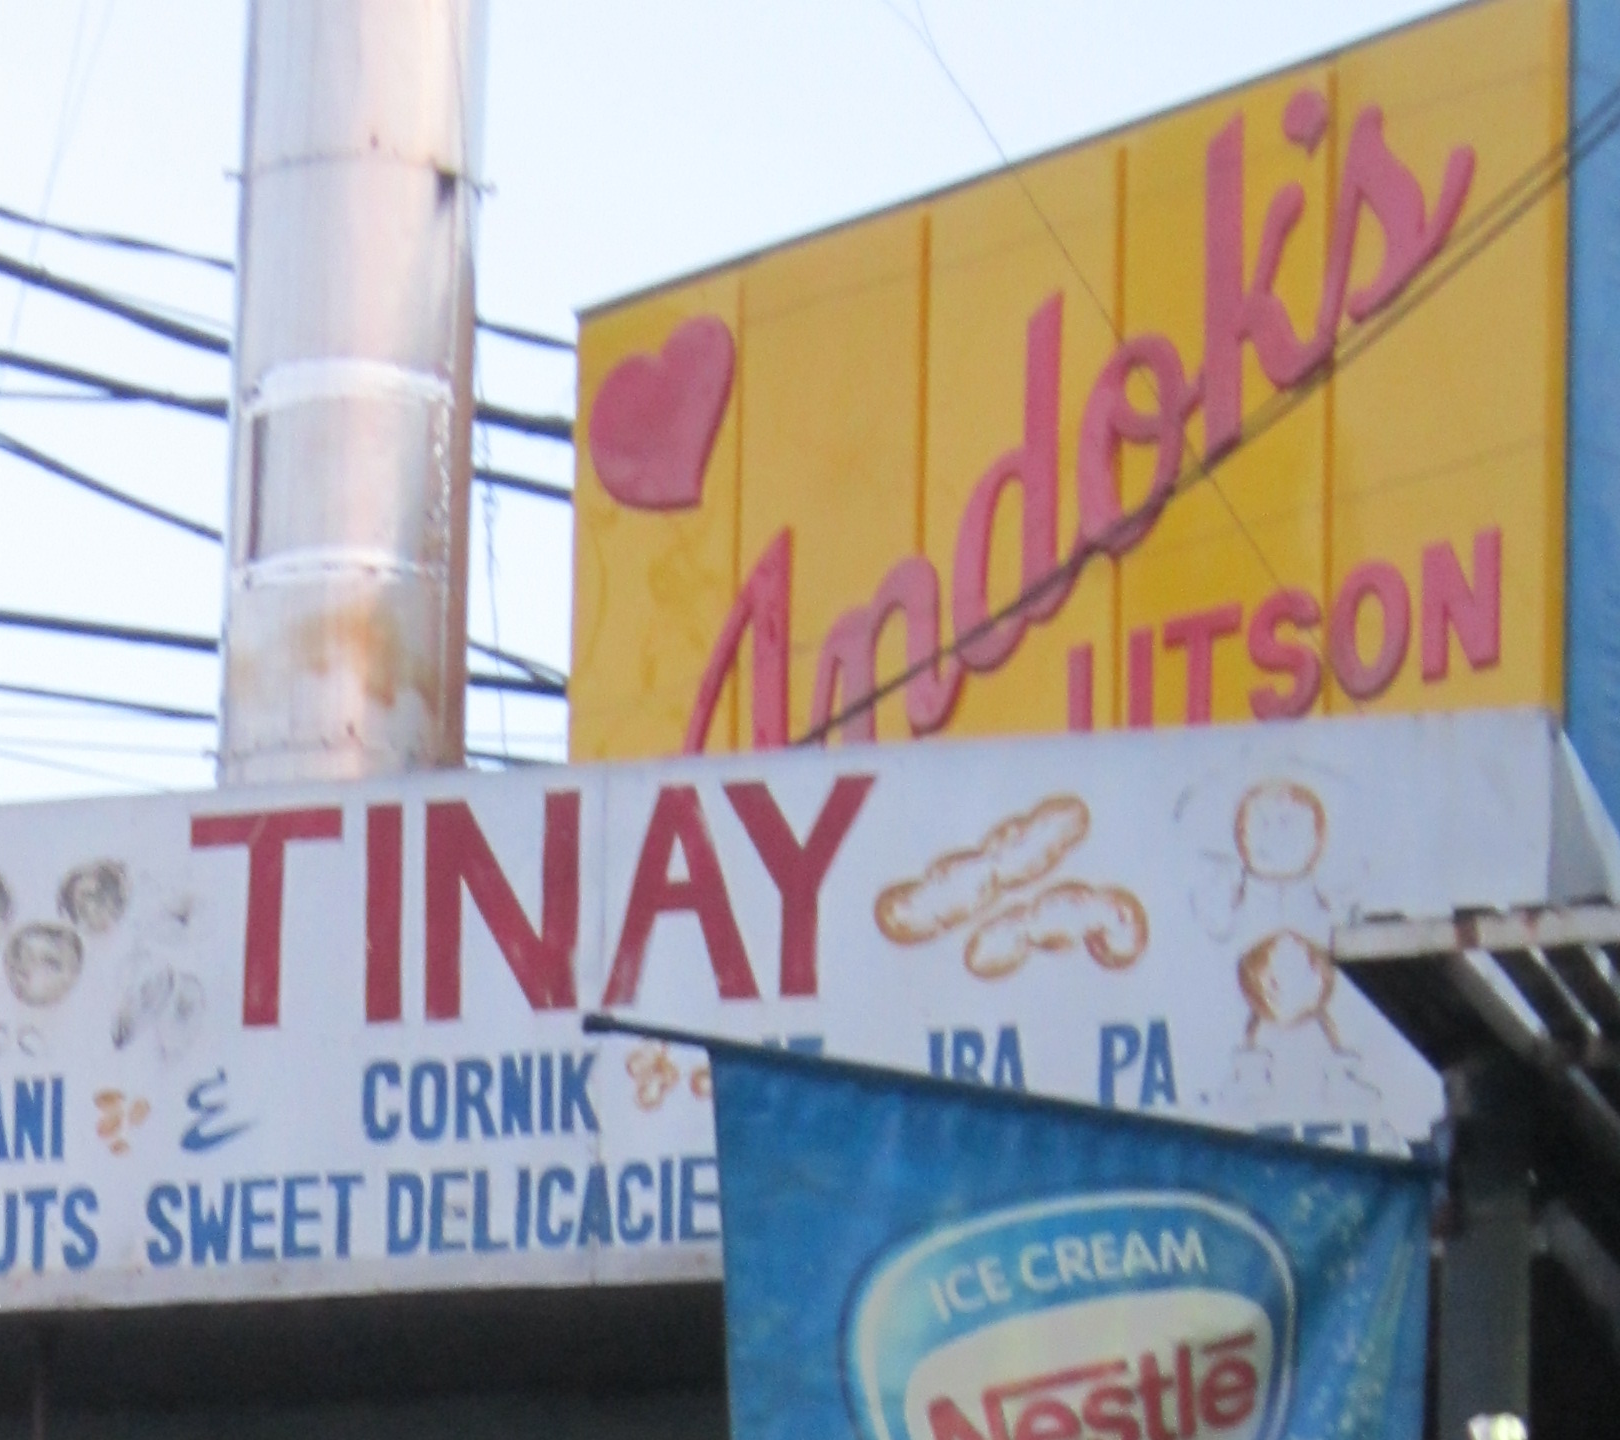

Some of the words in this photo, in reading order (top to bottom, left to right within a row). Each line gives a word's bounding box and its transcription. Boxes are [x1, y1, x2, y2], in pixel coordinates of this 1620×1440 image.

[683, 88, 1477, 754] Andok's
[190, 773, 877, 1030] TINAY
[361, 1052, 599, 1146] CORNIK
[146, 1174, 365, 1268] SWEET
[929, 1260, 1008, 1323] ICE
[1019, 1229, 1207, 1294] CREAM
